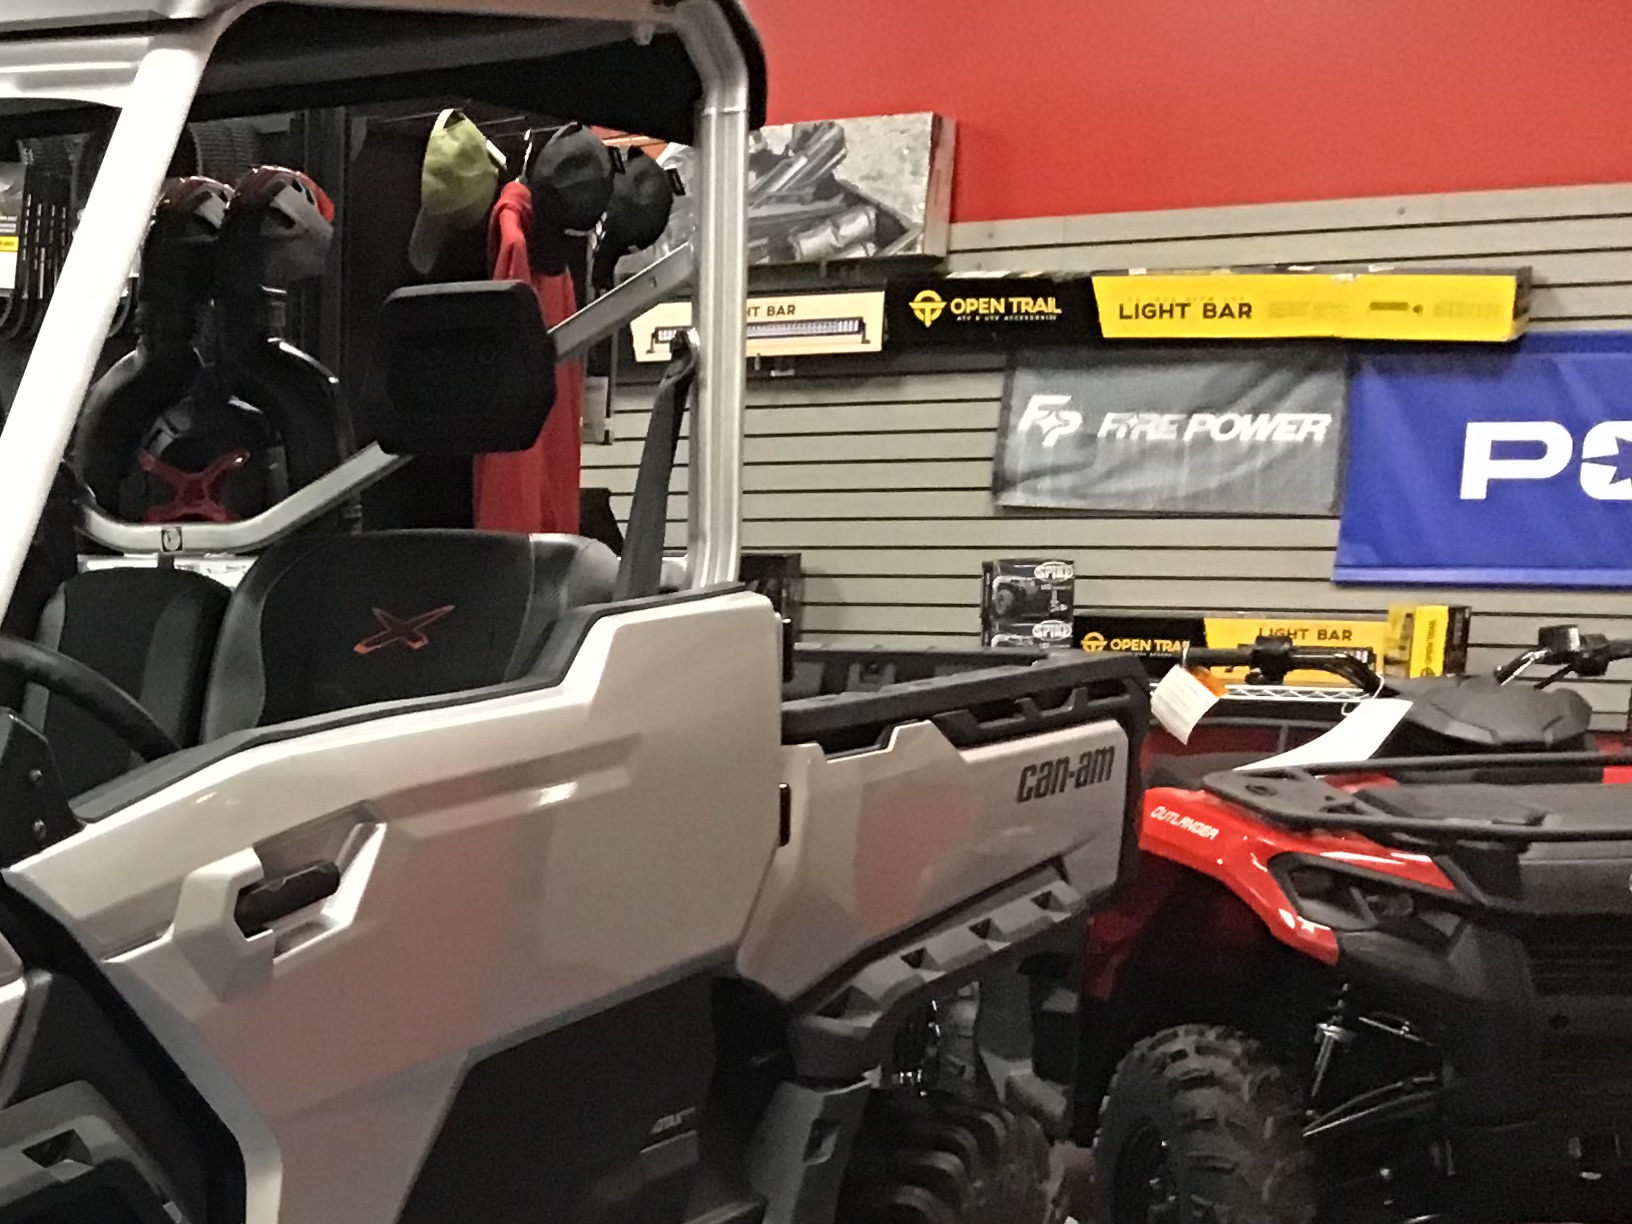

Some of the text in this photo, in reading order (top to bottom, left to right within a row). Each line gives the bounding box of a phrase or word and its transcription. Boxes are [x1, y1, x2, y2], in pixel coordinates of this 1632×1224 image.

[766, 304, 796, 317] BAR
[950, 297, 1062, 314] OPEN TRAIL
[1118, 302, 1191, 320] LIGHT
[1202, 302, 1253, 320] BAR
[1183, 412, 1333, 442] POWER
[1317, 629, 1353, 641] BAR
[1110, 638, 1183, 652] OPEN TRA
[1017, 746, 1116, 803] can-am
[1151, 806, 1220, 841] OUTLANDER
